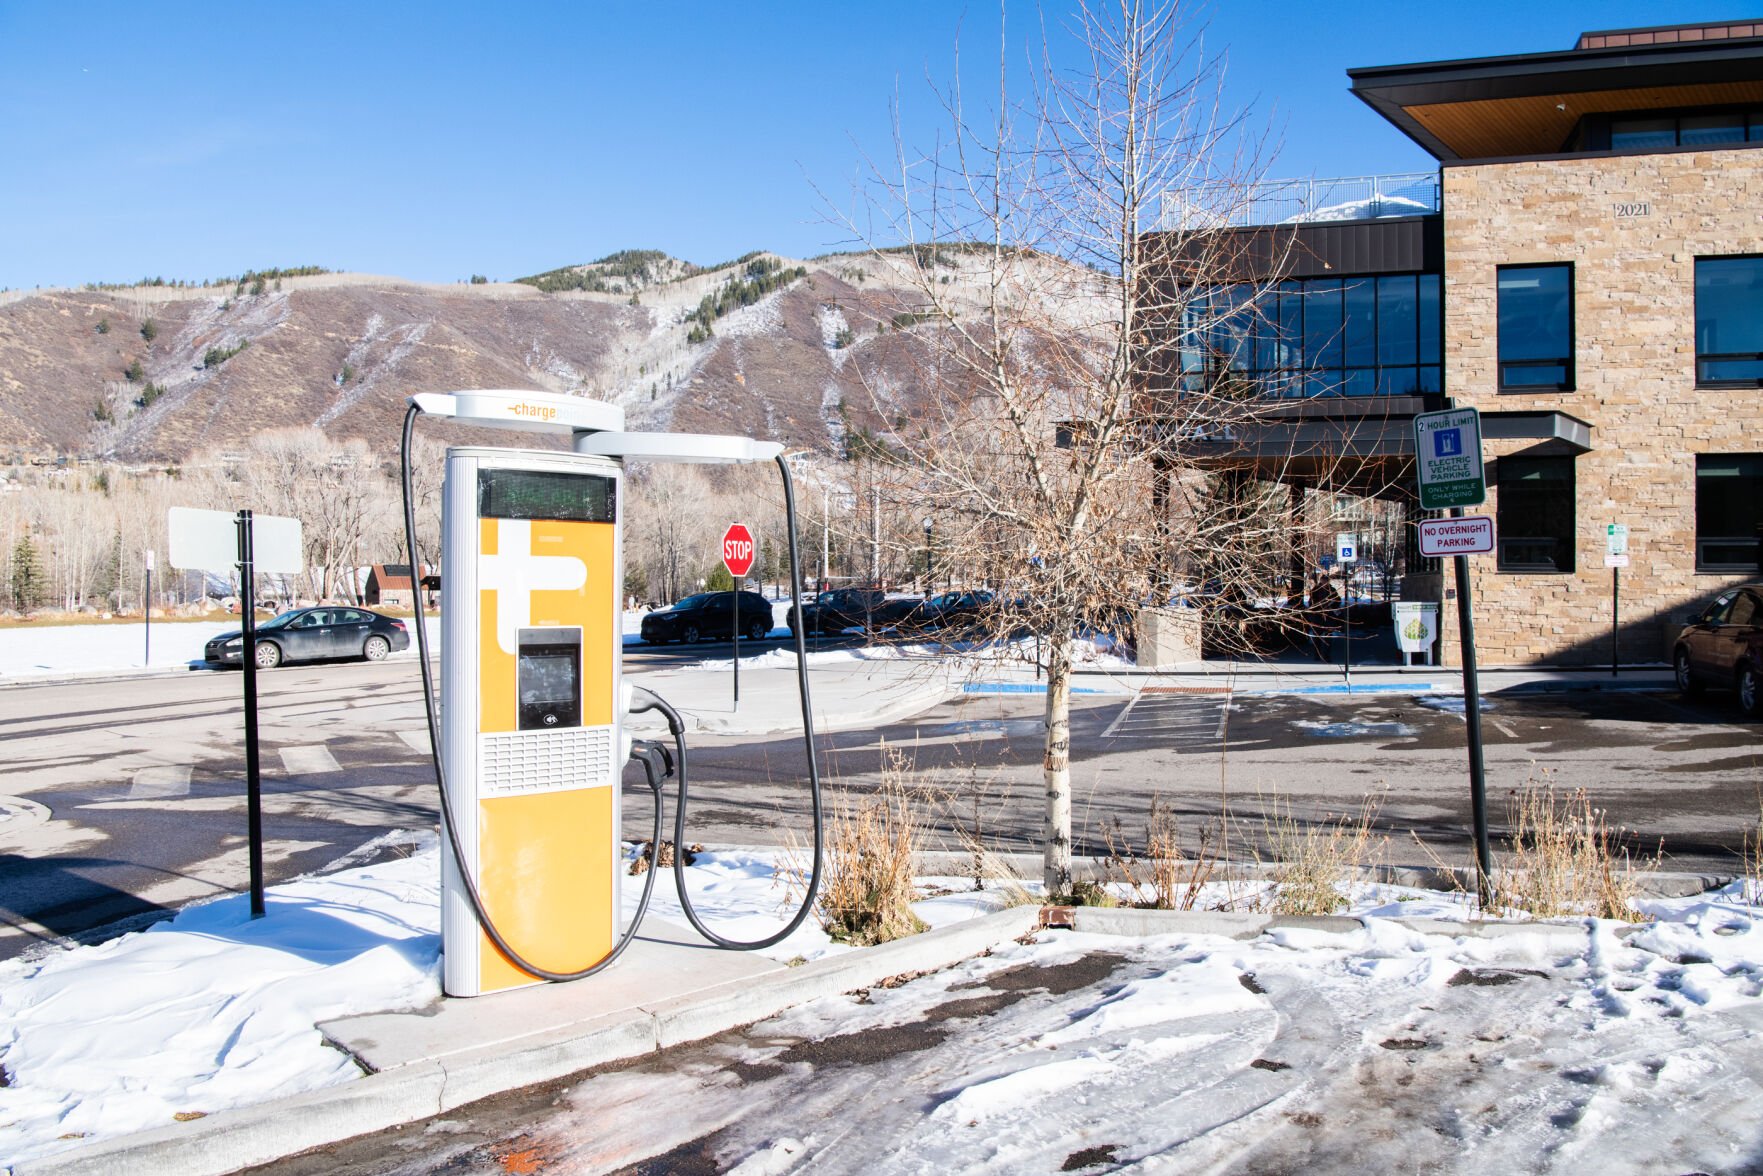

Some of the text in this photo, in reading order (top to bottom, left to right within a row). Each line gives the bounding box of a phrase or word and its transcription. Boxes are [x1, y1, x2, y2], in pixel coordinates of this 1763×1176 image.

[1617, 203, 1648, 217] 2021
[1418, 416, 1474, 432] 2 HOUR LIMIT
[1428, 456, 1471, 467] ELECTRIC
[1431, 463, 1469, 474] VEHICLE
[1431, 471, 1471, 480] PARKING
[1428, 482, 1476, 494] ONLY WHILE
[1432, 491, 1472, 500] CHARGING
[1424, 524, 1487, 537] NO OVERNIGHT
[1437, 537, 1476, 548] PARKING
[725, 540, 752, 560] STOP
